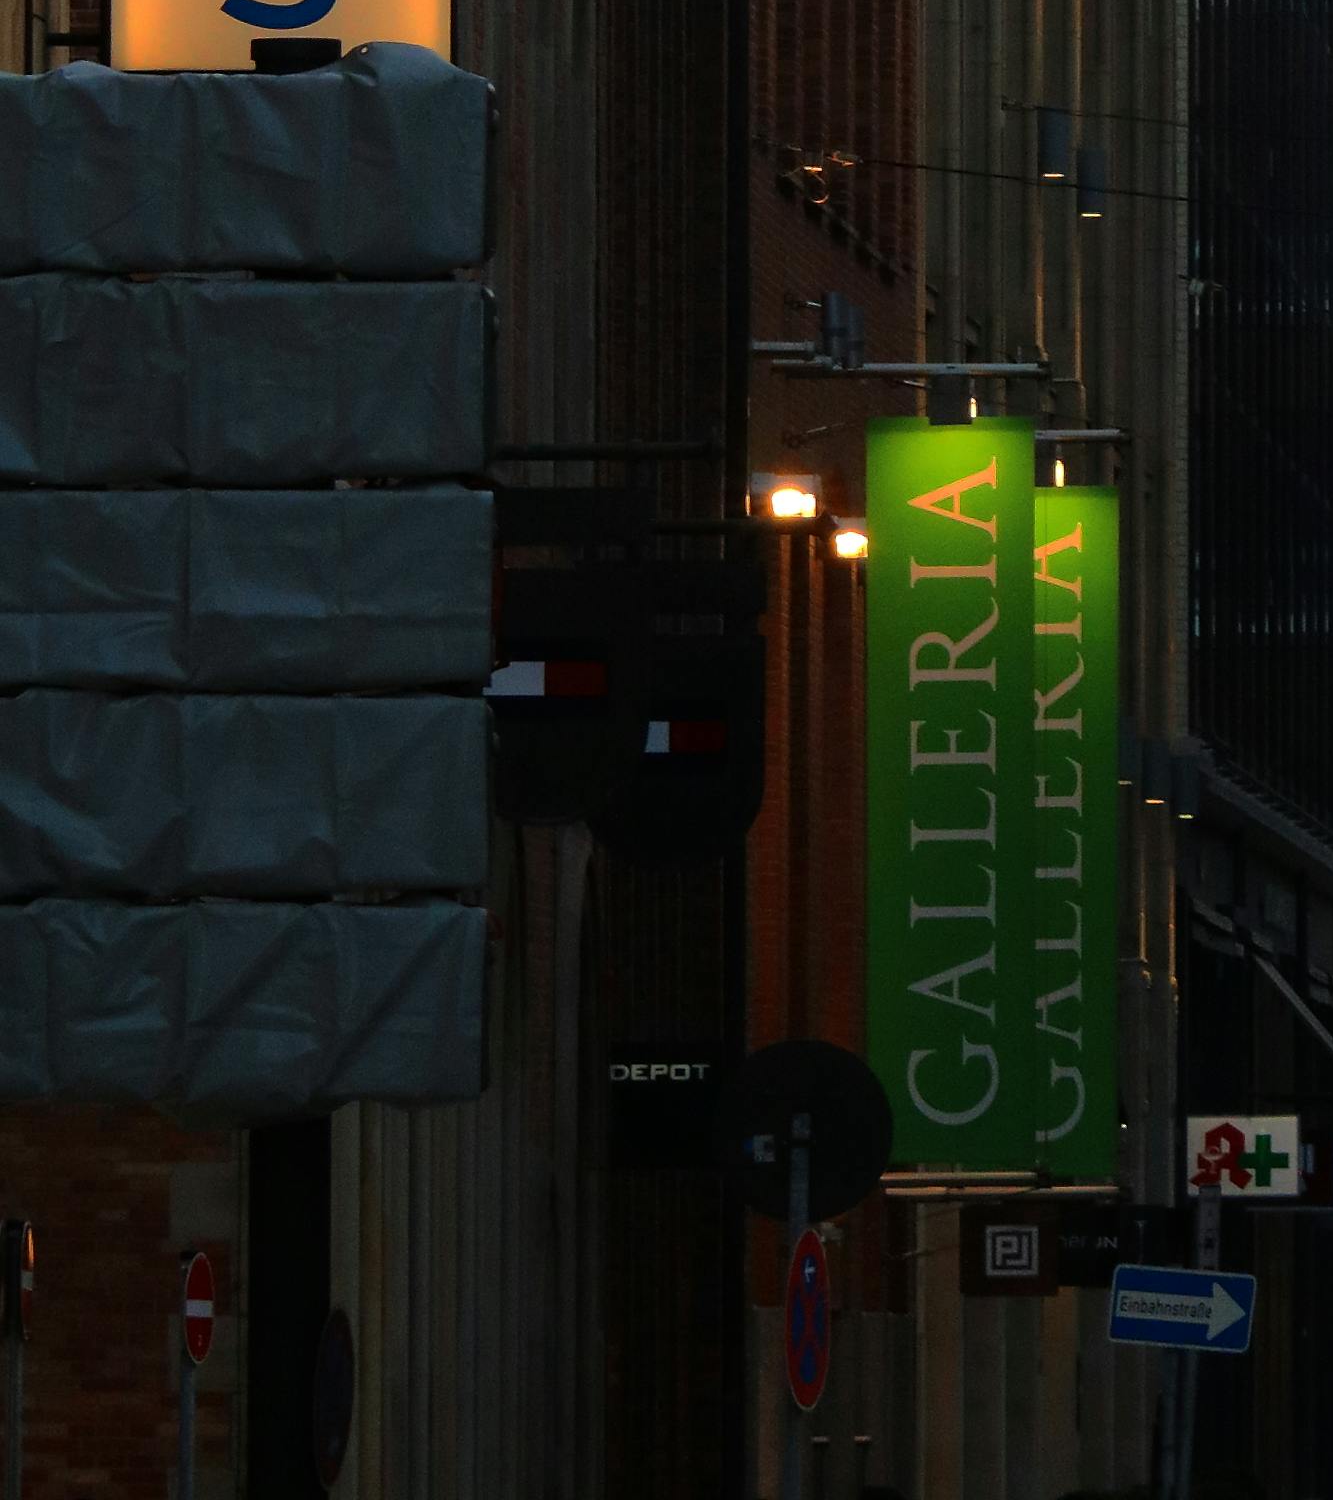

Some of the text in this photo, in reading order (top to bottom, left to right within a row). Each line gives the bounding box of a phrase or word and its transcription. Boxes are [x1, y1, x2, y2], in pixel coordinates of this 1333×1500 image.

[907, 455, 1000, 1127] GALLERIA
[609, 1063, 711, 1081] DEPOT
[1120, 1295, 1213, 1319] Einbahnstraße
